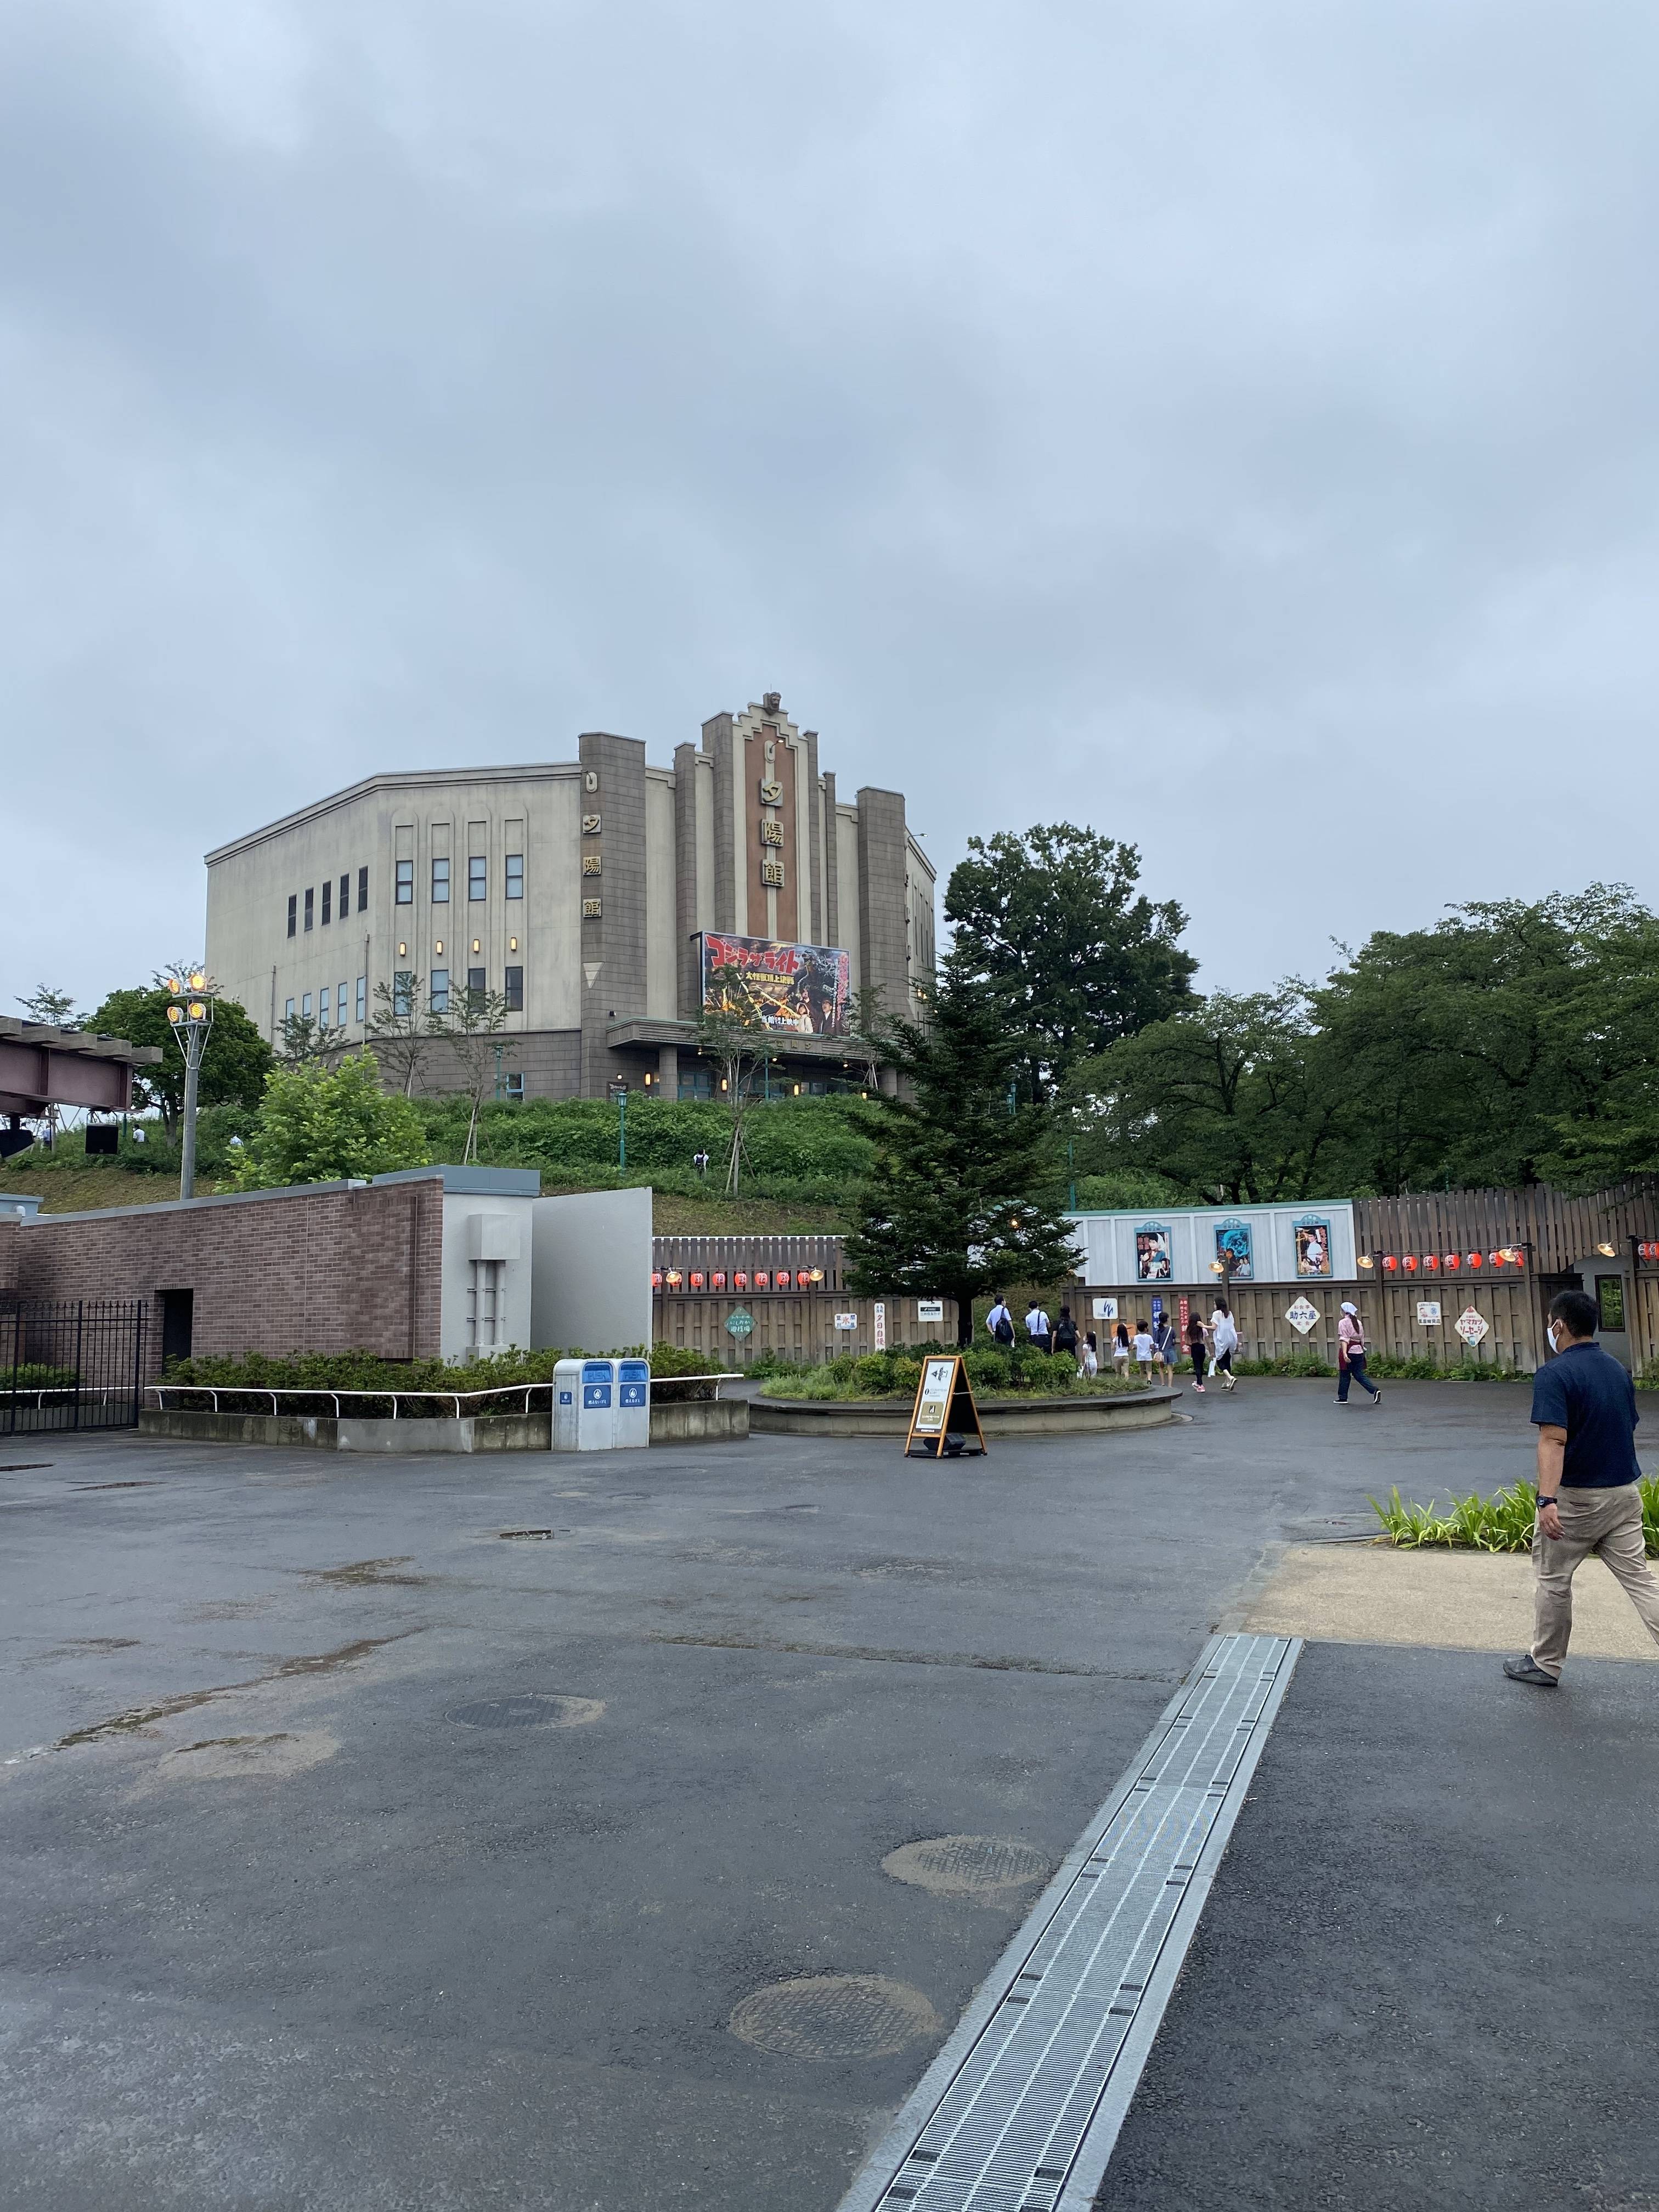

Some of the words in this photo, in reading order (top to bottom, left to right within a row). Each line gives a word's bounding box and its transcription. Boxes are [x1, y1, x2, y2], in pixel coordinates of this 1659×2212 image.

[761, 780, 784, 887] 夕陽館
[583, 814, 601, 918] 夕陽館
[876, 1314, 885, 1346] 夕日自慢
[1290, 1310, 1317, 1320] 助六屋
[1460, 1325, 1483, 1335] ソーセージ
